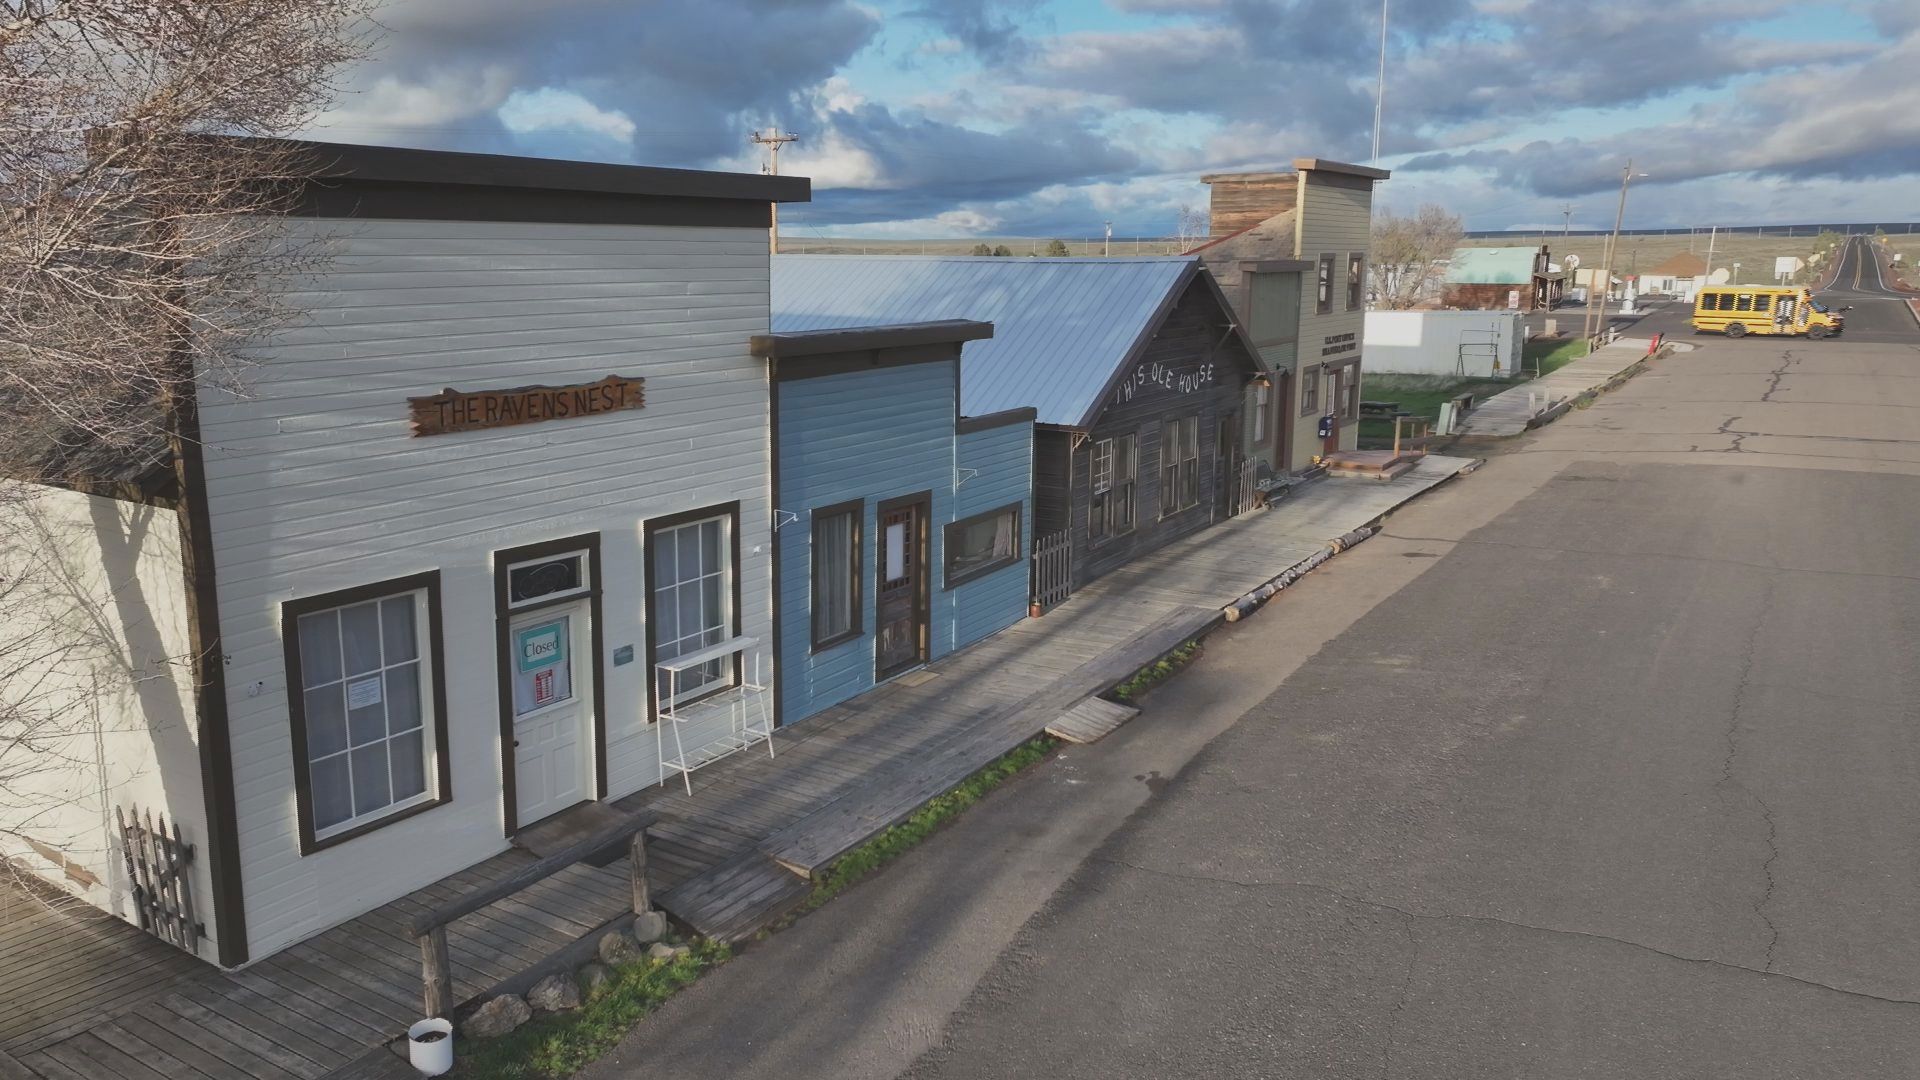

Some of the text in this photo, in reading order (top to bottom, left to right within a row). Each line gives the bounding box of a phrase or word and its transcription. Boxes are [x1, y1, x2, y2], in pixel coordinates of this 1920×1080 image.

[1116, 362, 1214, 404] THIS OLE HOUSE
[434, 382, 628, 427] THE RAVENS NEST
[523, 635, 559, 658] Closed
